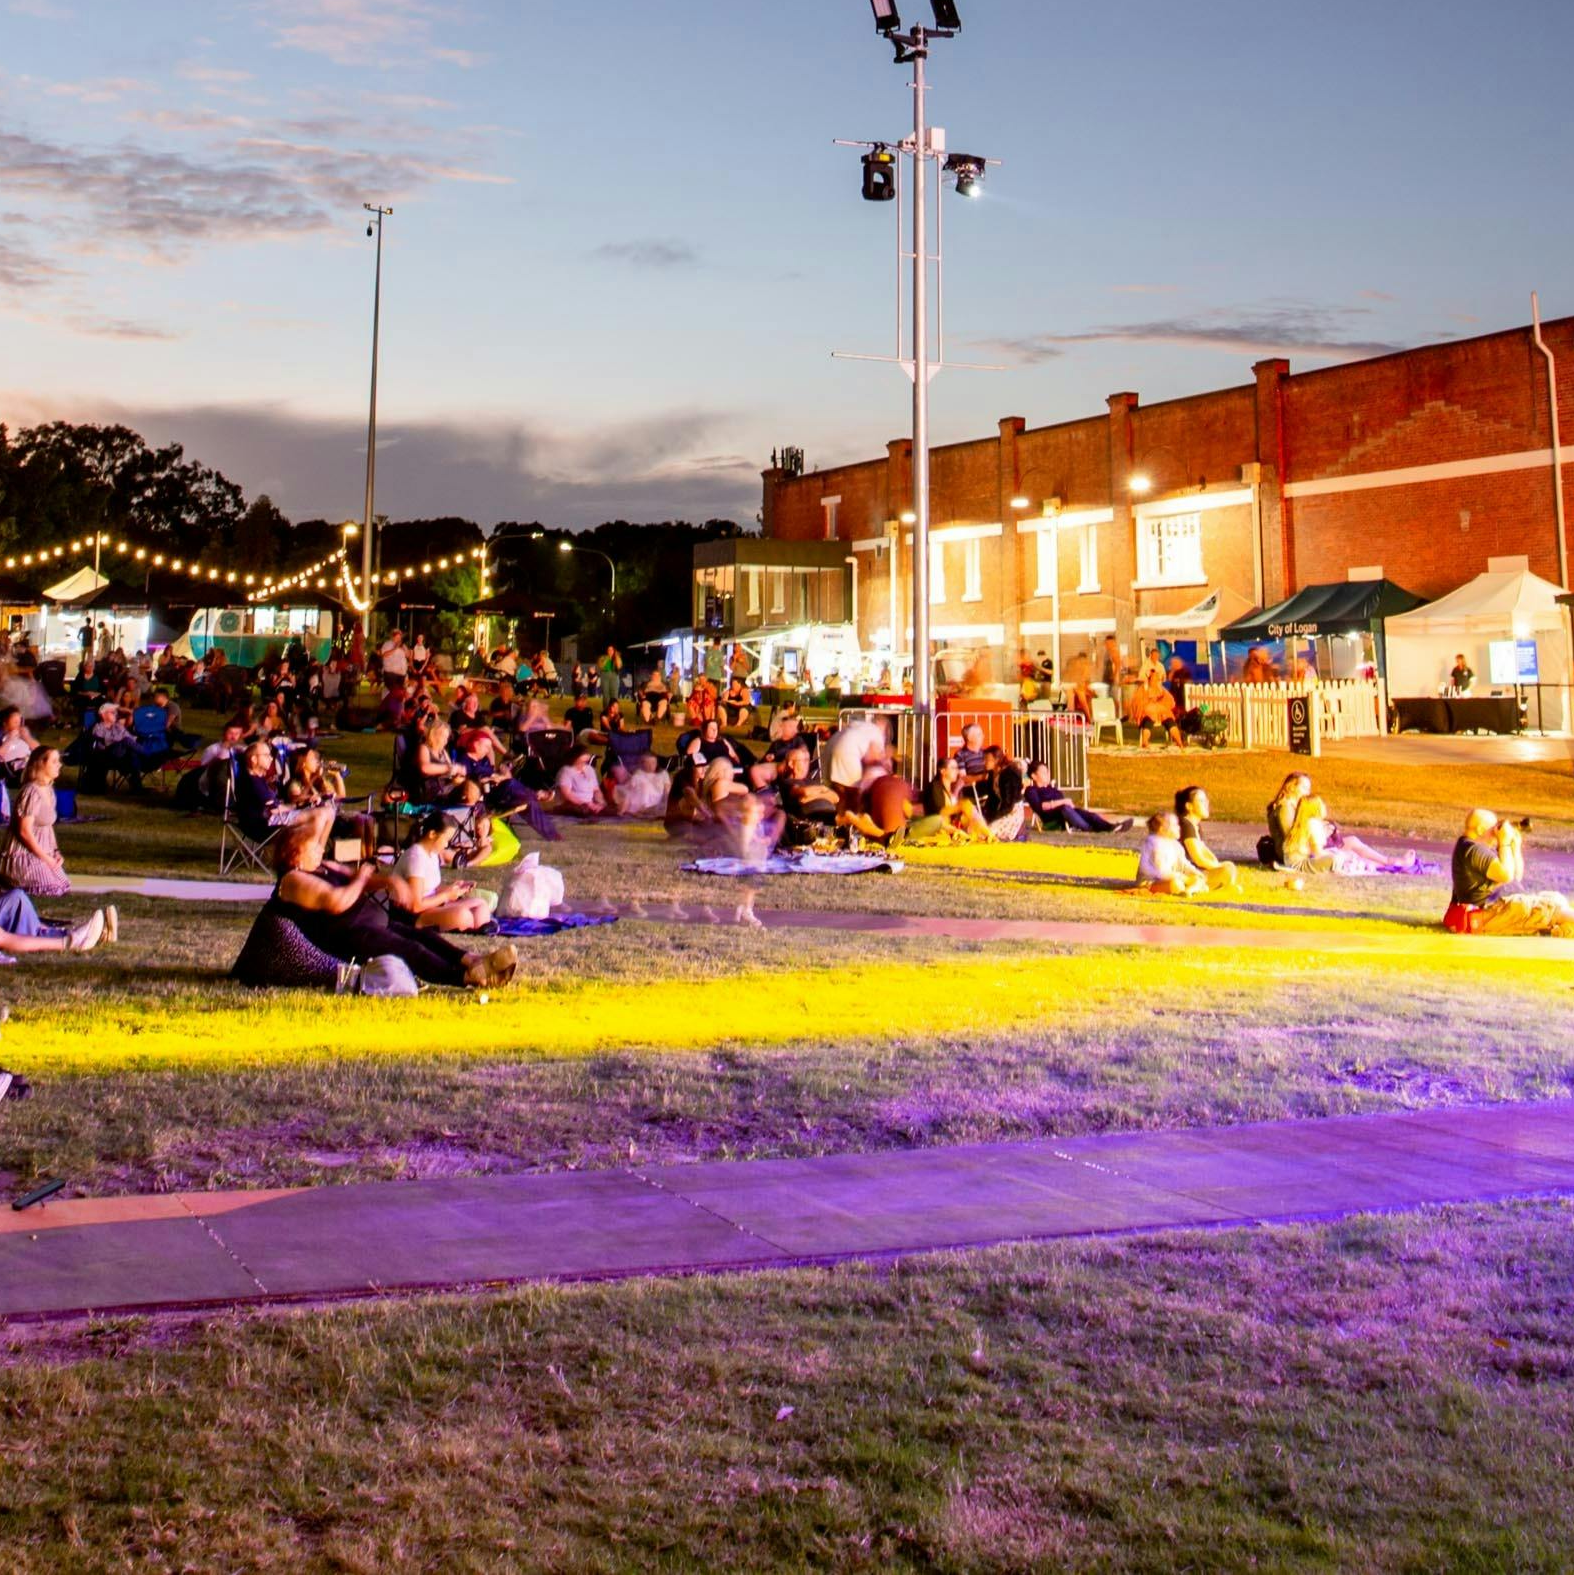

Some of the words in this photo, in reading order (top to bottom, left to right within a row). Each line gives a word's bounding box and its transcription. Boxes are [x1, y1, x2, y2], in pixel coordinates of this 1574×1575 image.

[1267, 623, 1284, 637] City
[1284, 622, 1293, 635] of
[1293, 622, 1318, 635] Logan
